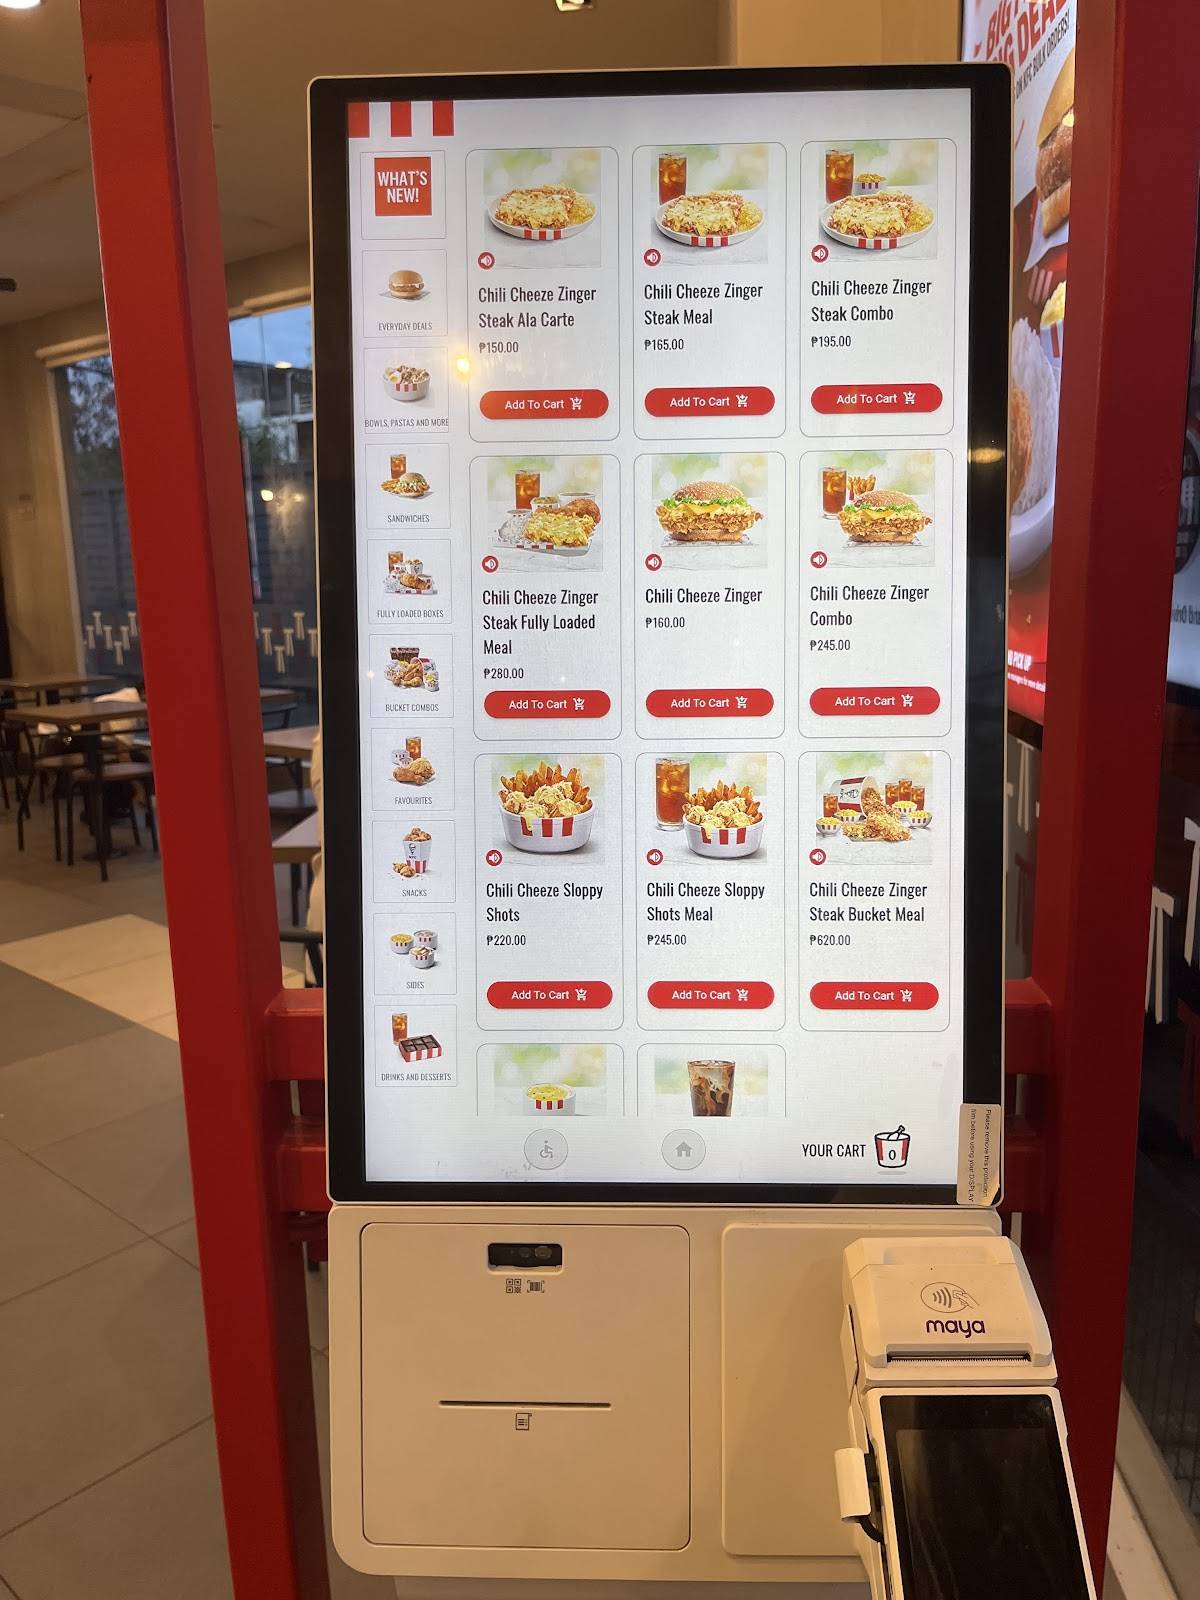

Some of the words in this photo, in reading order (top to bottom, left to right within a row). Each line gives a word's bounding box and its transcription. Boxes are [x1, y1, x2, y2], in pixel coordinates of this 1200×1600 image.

[1046, 9, 1070, 58] ORDERS!
[377, 170, 428, 187] WHAT'S
[387, 188, 419, 203] NEW!
[478, 287, 506, 303] Chili
[510, 286, 554, 302] Cheeze
[558, 286, 597, 304] Zinger
[644, 284, 672, 300] Chili
[676, 283, 720, 299] Cheeze
[724, 282, 763, 301] Zinger
[812, 280, 839, 296] Chili
[844, 280, 888, 296] Cheeze
[892, 278, 932, 297] Zinger
[478, 312, 514, 328] Steak
[517, 312, 537, 328] Ala
[541, 312, 574, 327] Carte
[644, 309, 680, 325] Steak
[684, 308, 712, 324] Meal
[811, 306, 847, 322] Steak
[851, 305, 894, 321] Combo
[378, 322, 411, 331] EVERYDAY
[412, 322, 432, 330] DEALS
[504, 400, 525, 410] Add
[527, 400, 540, 410] To
[543, 400, 564, 409] Cart
[670, 397, 690, 407] Add
[692, 397, 706, 406] To
[708, 396, 730, 406] Cart
[836, 394, 858, 404] Add
[859, 394, 873, 404] To
[875, 394, 898, 403] Cart
[390, 418, 415, 427] PASTAS
[416, 418, 430, 426] AND
[430, 418, 448, 427] MORE
[387, 514, 430, 523] SANDWICHES
[482, 590, 510, 605] Chili
[514, 590, 557, 605] Cheeze
[561, 589, 599, 608] Zinger
[646, 588, 673, 604] Chili
[677, 588, 720, 603] Cheeze
[724, 587, 763, 605] Zinger
[810, 586, 838, 601] Chili
[842, 585, 886, 600] Cheeze
[890, 584, 930, 602] Zinger
[376, 610, 396, 618] FULLY
[397, 609, 422, 618] LOADED
[423, 609, 444, 618] BOXES
[810, 610, 852, 626] Combo
[483, 614, 518, 630] Steak
[521, 614, 549, 632] Fully
[553, 614, 595, 629] Loaded
[484, 639, 512, 654] Meal
[385, 704, 410, 712] BUCKET
[411, 704, 439, 712] COMBOS
[509, 700, 528, 709] Add
[531, 700, 544, 709] To
[546, 700, 567, 709] Cart
[670, 698, 690, 708] Add
[693, 698, 706, 708] To
[708, 698, 730, 708] Cart
[834, 696, 856, 706] Add
[858, 696, 871, 706] To
[873, 696, 896, 706] Cart
[394, 796, 433, 805] FAVOURITES
[402, 889, 427, 897] SNACKS
[486, 883, 513, 898] Chili
[517, 882, 559, 898] Cheeze
[563, 882, 603, 900] Sloppy
[647, 882, 674, 897] Chili
[678, 882, 720, 897] Cheeze
[724, 882, 765, 900] Sloppy
[810, 882, 837, 897] Chili
[841, 882, 885, 897] Cheeze
[889, 882, 928, 900] Zinger
[486, 907, 520, 922] Shots
[647, 906, 680, 921] Shots
[684, 906, 713, 921] Meal
[810, 906, 844, 922] Steak
[848, 906, 891, 922] Bucket
[896, 907, 924, 922] Meal
[406, 981, 424, 989] SIDES
[511, 990, 531, 1000] Add
[533, 990, 546, 1000] To
[548, 990, 570, 1000] Cart
[672, 990, 692, 1000] Add
[694, 990, 708, 1000] To
[709, 990, 731, 1000] Cart
[834, 991, 855, 1000] Add
[857, 991, 871, 1000] To
[872, 991, 894, 1000] Cart
[381, 1073, 405, 1082] DRINKS
[406, 1073, 419, 1081] AND
[420, 1072, 452, 1081] DESSERTS
[802, 1144, 833, 1157] YOUR
[836, 1144, 866, 1158] CART
[888, 1149, 896, 1161] 0
[983, 1155, 991, 1166] this
[926, 1319, 985, 1338] maya
